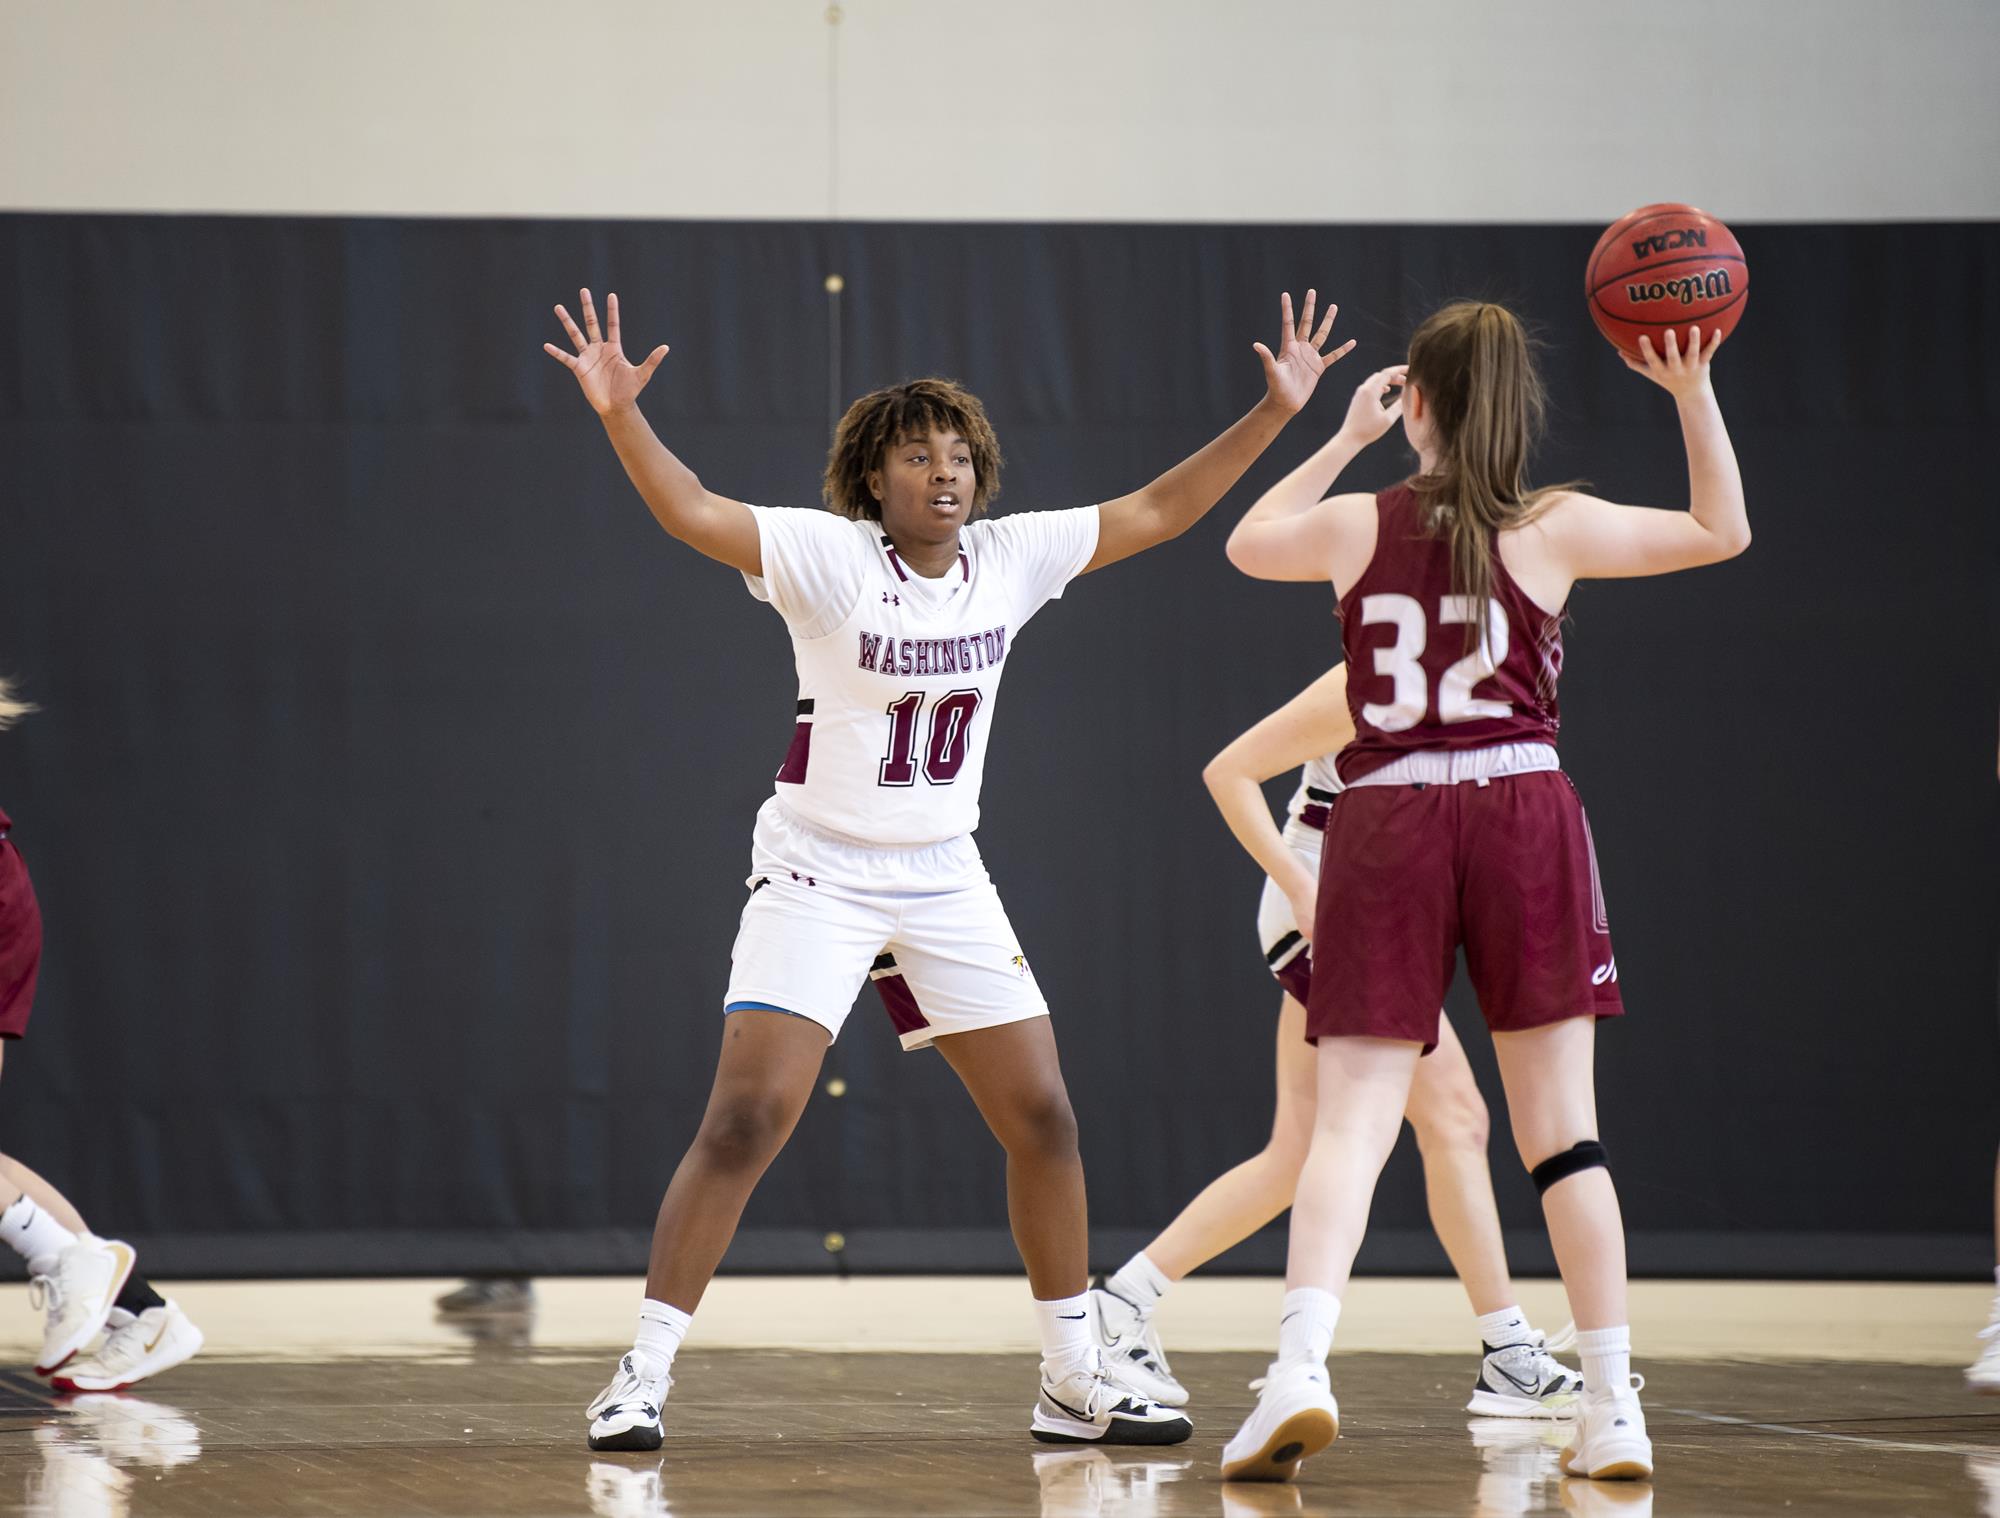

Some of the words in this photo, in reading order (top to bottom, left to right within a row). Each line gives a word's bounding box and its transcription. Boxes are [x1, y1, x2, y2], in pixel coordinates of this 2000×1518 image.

[1632, 229, 1707, 259] NCAA
[1627, 269, 1732, 304] Wilson
[858, 625, 1006, 676] WASHINGTON
[1361, 593, 1513, 732] 32
[878, 688, 983, 786] 10
